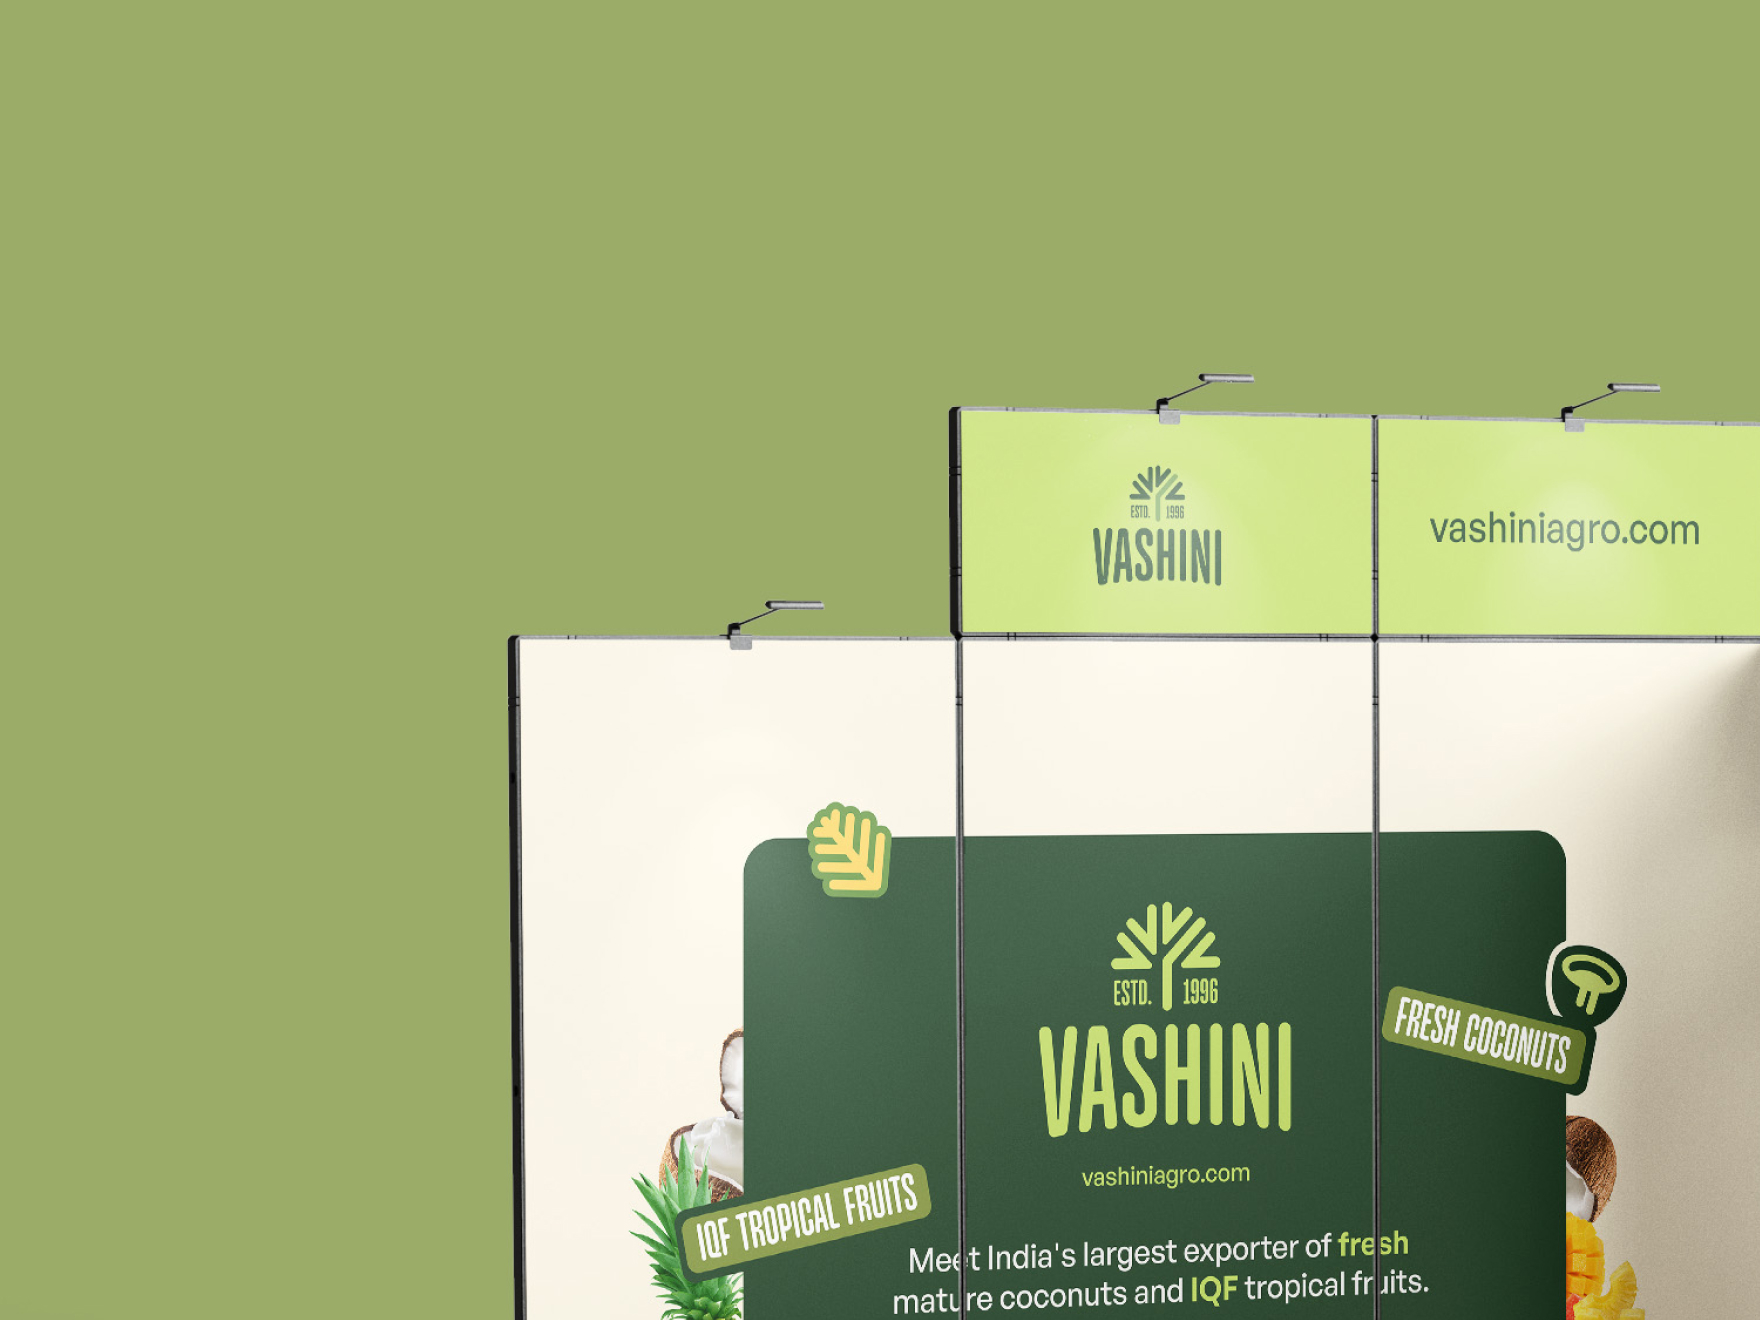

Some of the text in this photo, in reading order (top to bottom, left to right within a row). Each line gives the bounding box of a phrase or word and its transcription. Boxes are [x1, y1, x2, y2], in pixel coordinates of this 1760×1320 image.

[1130, 505, 1184, 519] ESTD. 1996
[1430, 511, 1700, 551] vashiniagro.com
[1093, 528, 1221, 586] VASHINI
[1114, 978, 1219, 1006] ESTD. 1996
[1395, 997, 1571, 1074] FRESH COCONUTS
[1039, 1022, 1292, 1138] VASHINI
[1082, 1165, 1250, 1189] vashiniagro.com
[696, 1172, 919, 1262] IQF TROPICAL FRUITS
[988, 1244, 1077, 1271] India's
[1083, 1239, 1178, 1272] largest
[1183, 1236, 1299, 1267] exporter
[1305, 1232, 1332, 1258] of
[1337, 1230, 1409, 1257] fresh
[893, 1269, 1430, 1315] mature coconuts and IQF tropical fruits.
